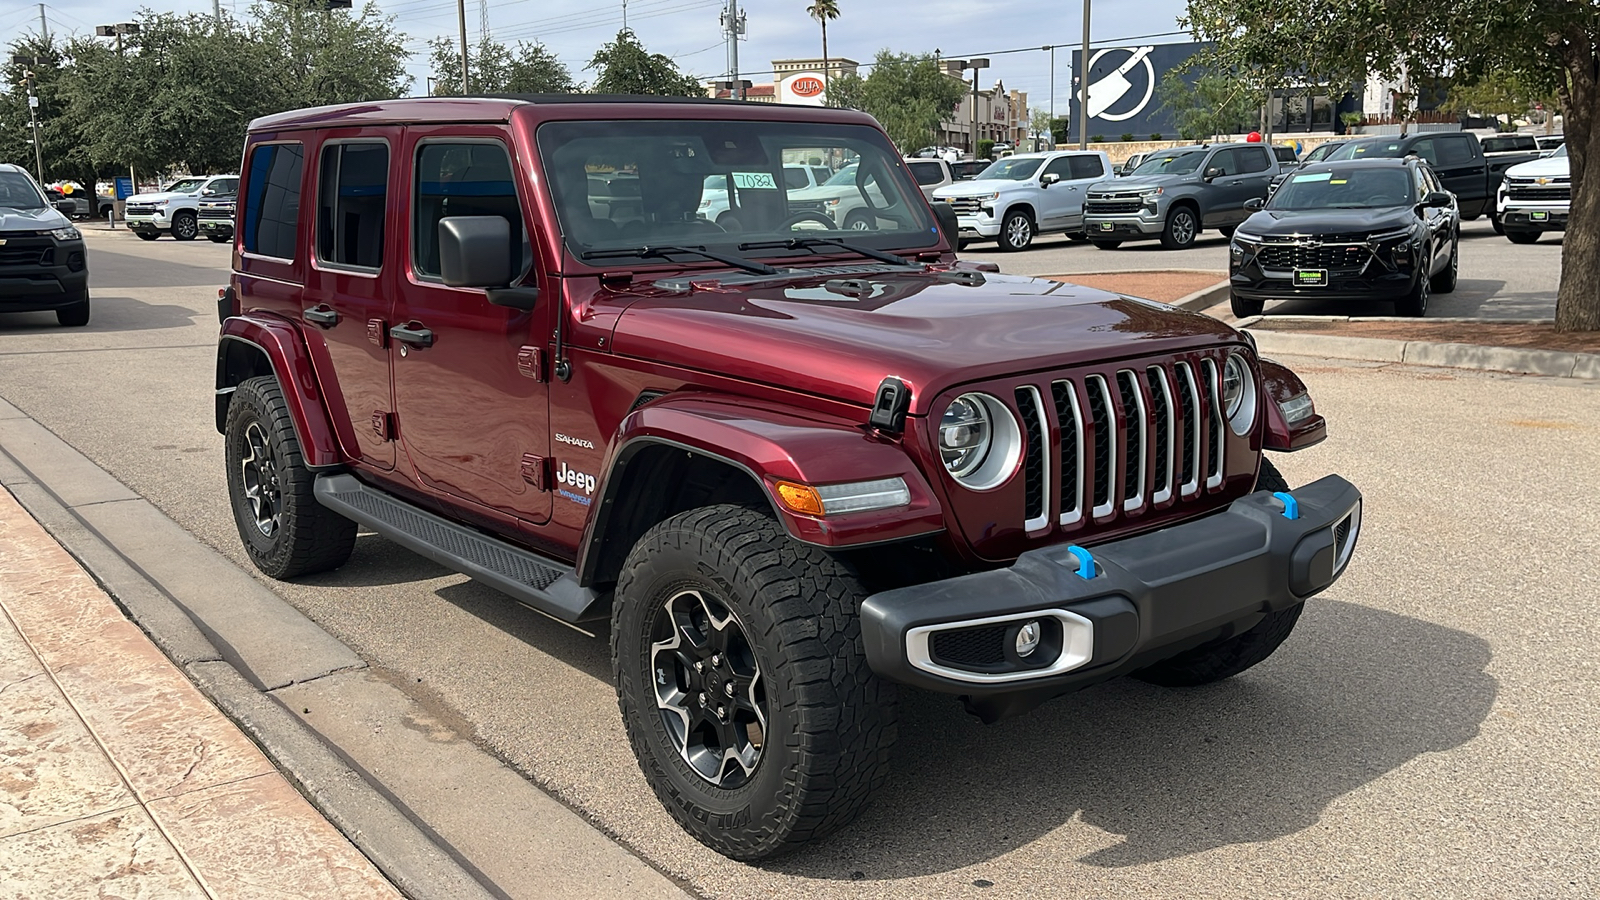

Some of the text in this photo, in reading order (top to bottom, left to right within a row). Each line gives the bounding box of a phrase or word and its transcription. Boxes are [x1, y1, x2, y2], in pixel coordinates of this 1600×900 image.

[796, 81, 820, 90] ULTA
[733, 174, 773, 188] 7082
[555, 433, 594, 449] SAHARA
[556, 462, 596, 495] Jeep
